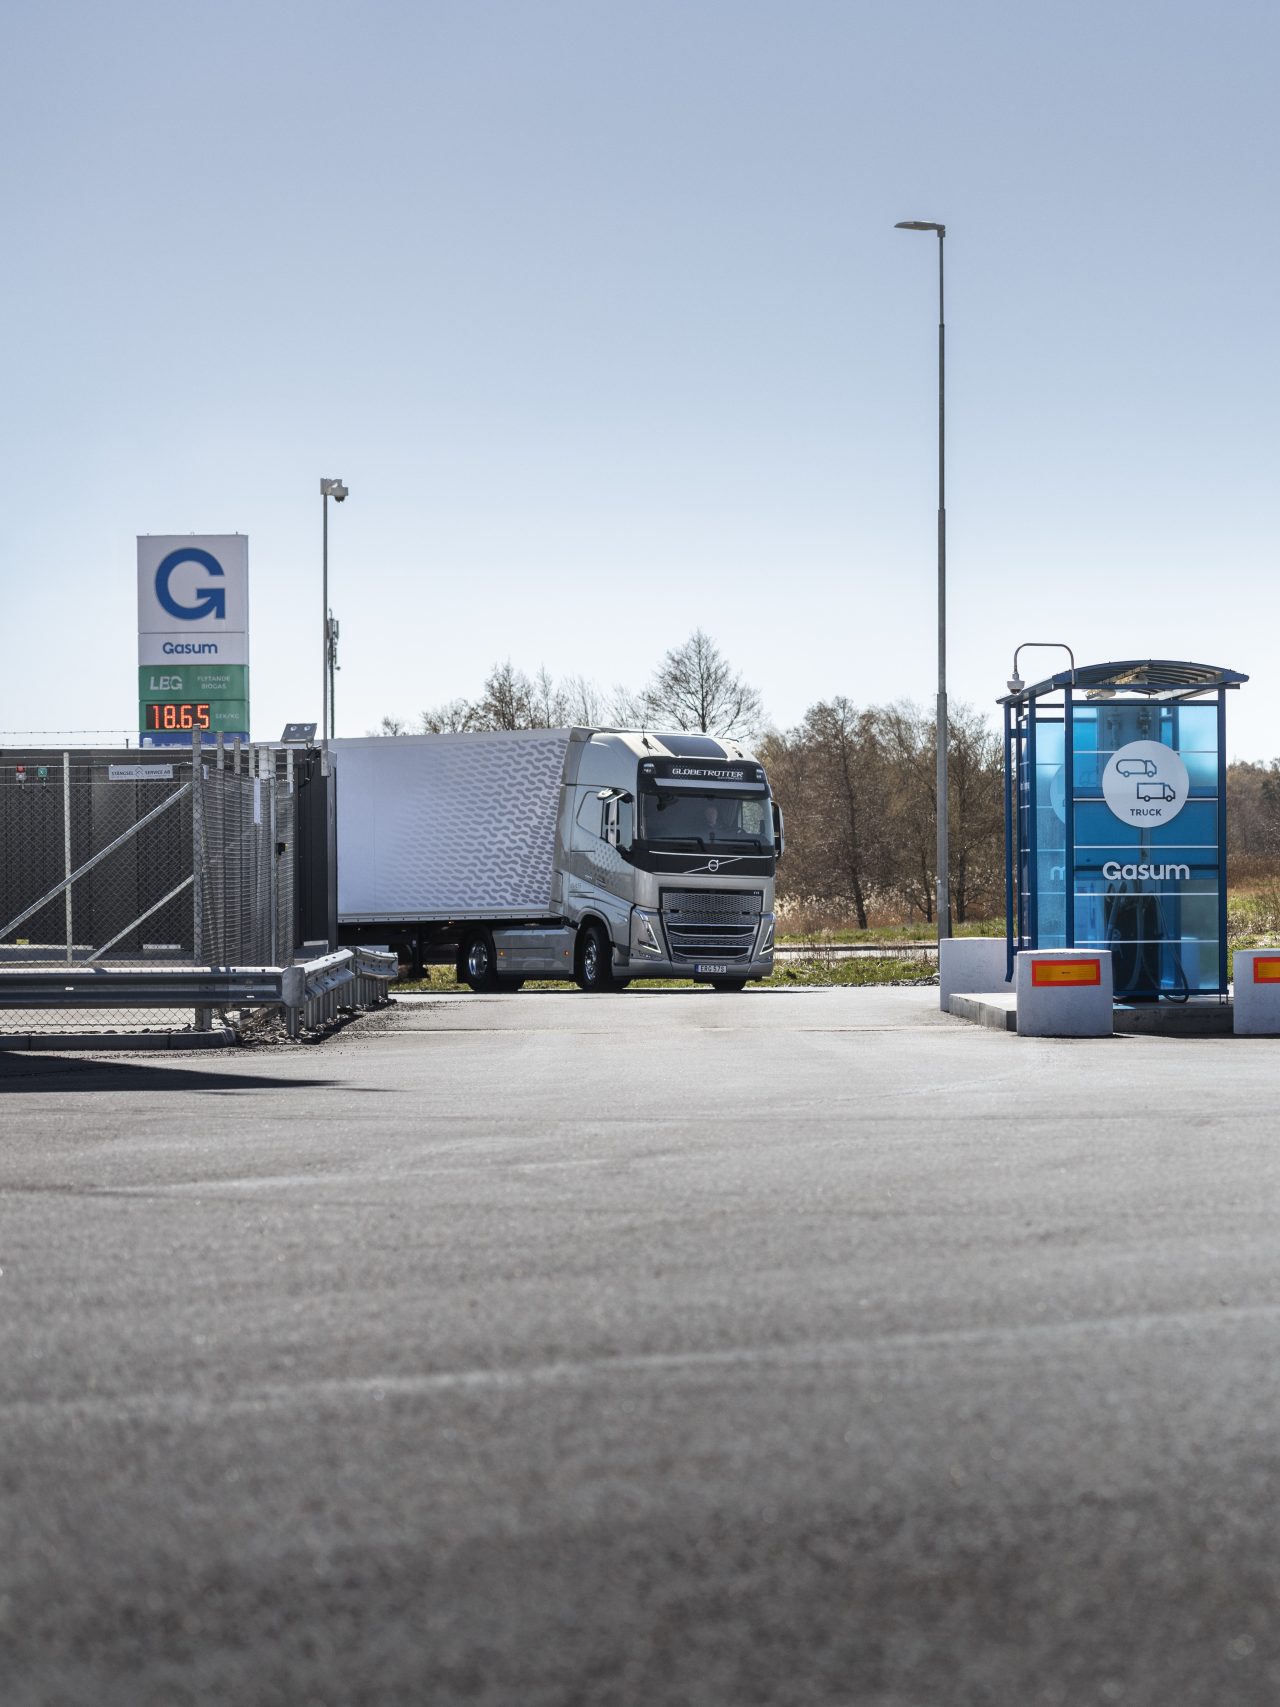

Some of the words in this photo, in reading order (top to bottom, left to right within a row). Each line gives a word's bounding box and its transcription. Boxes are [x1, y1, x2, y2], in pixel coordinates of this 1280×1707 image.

[162, 642, 218, 654] Gasum
[150, 676, 183, 691] LBG
[153, 704, 209, 729] 18.65
[672, 768, 744, 778] GLOBETROTTER
[1129, 808, 1162, 816] TRUCK
[1102, 861, 1190, 880] Gasum
